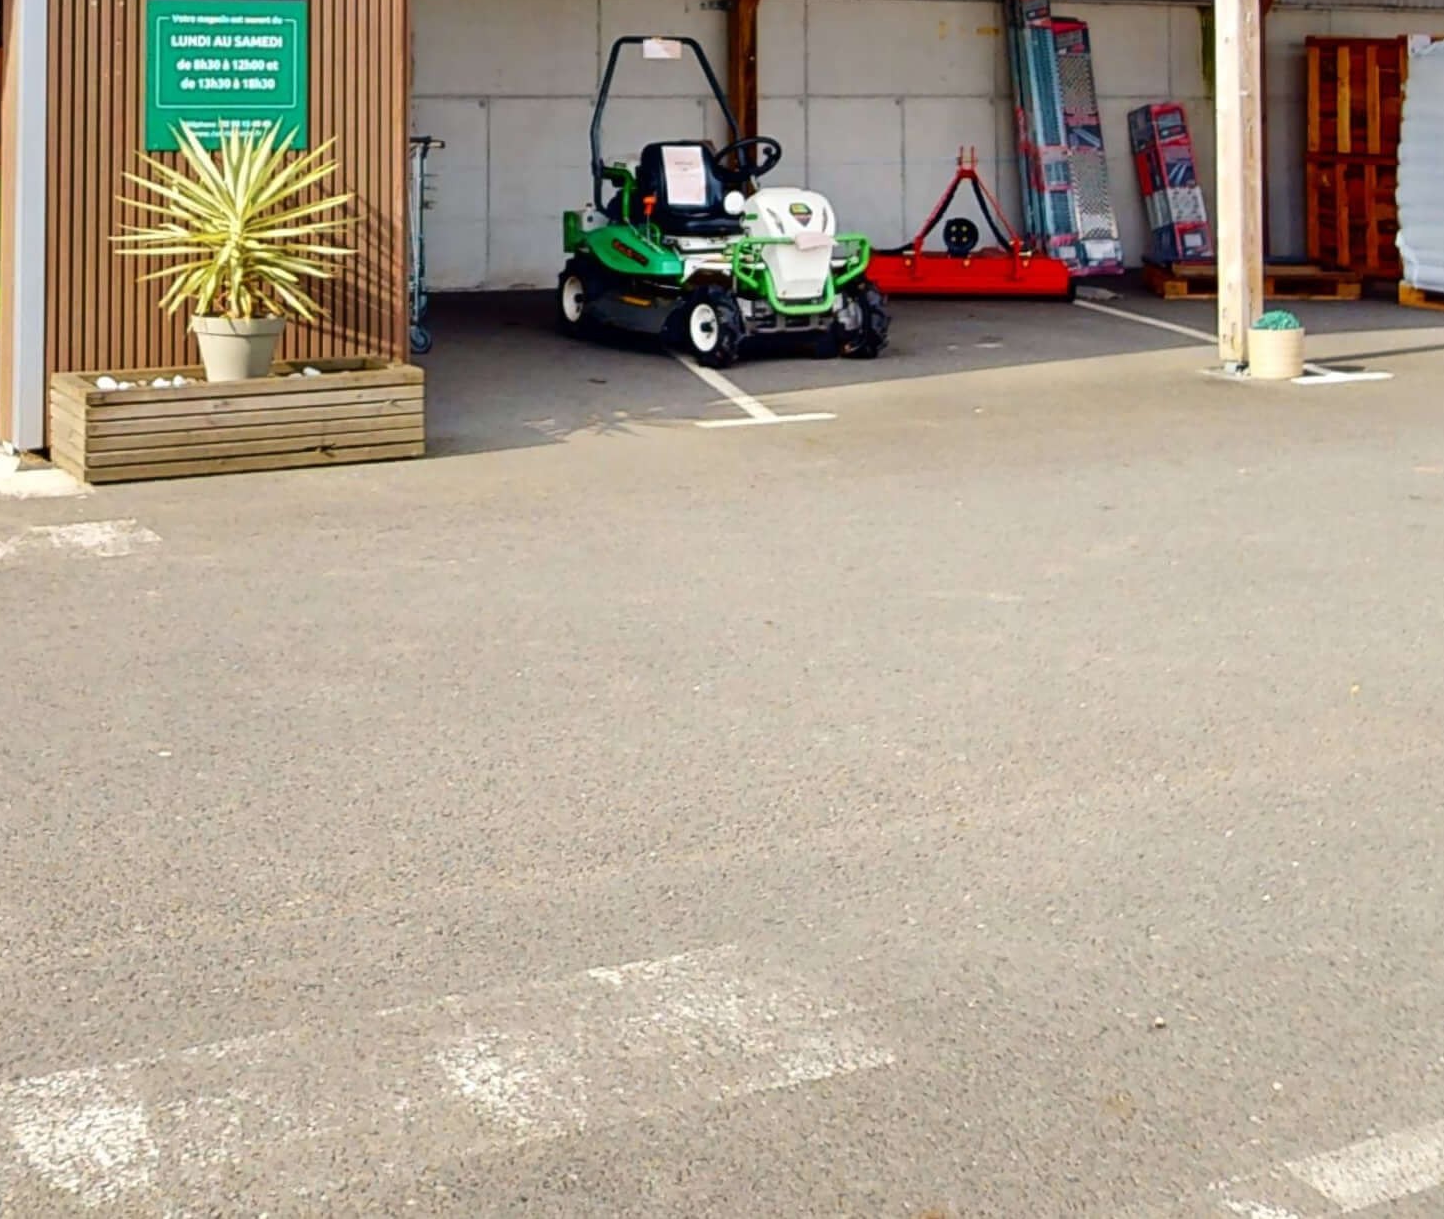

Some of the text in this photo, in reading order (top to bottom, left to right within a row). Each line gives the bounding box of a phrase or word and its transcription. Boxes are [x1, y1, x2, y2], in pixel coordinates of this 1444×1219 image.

[170, 35, 283, 48] LUNDI AU SAMEDI
[176, 58, 192, 71] de
[266, 60, 279, 71] et
[180, 77, 196, 90] de
